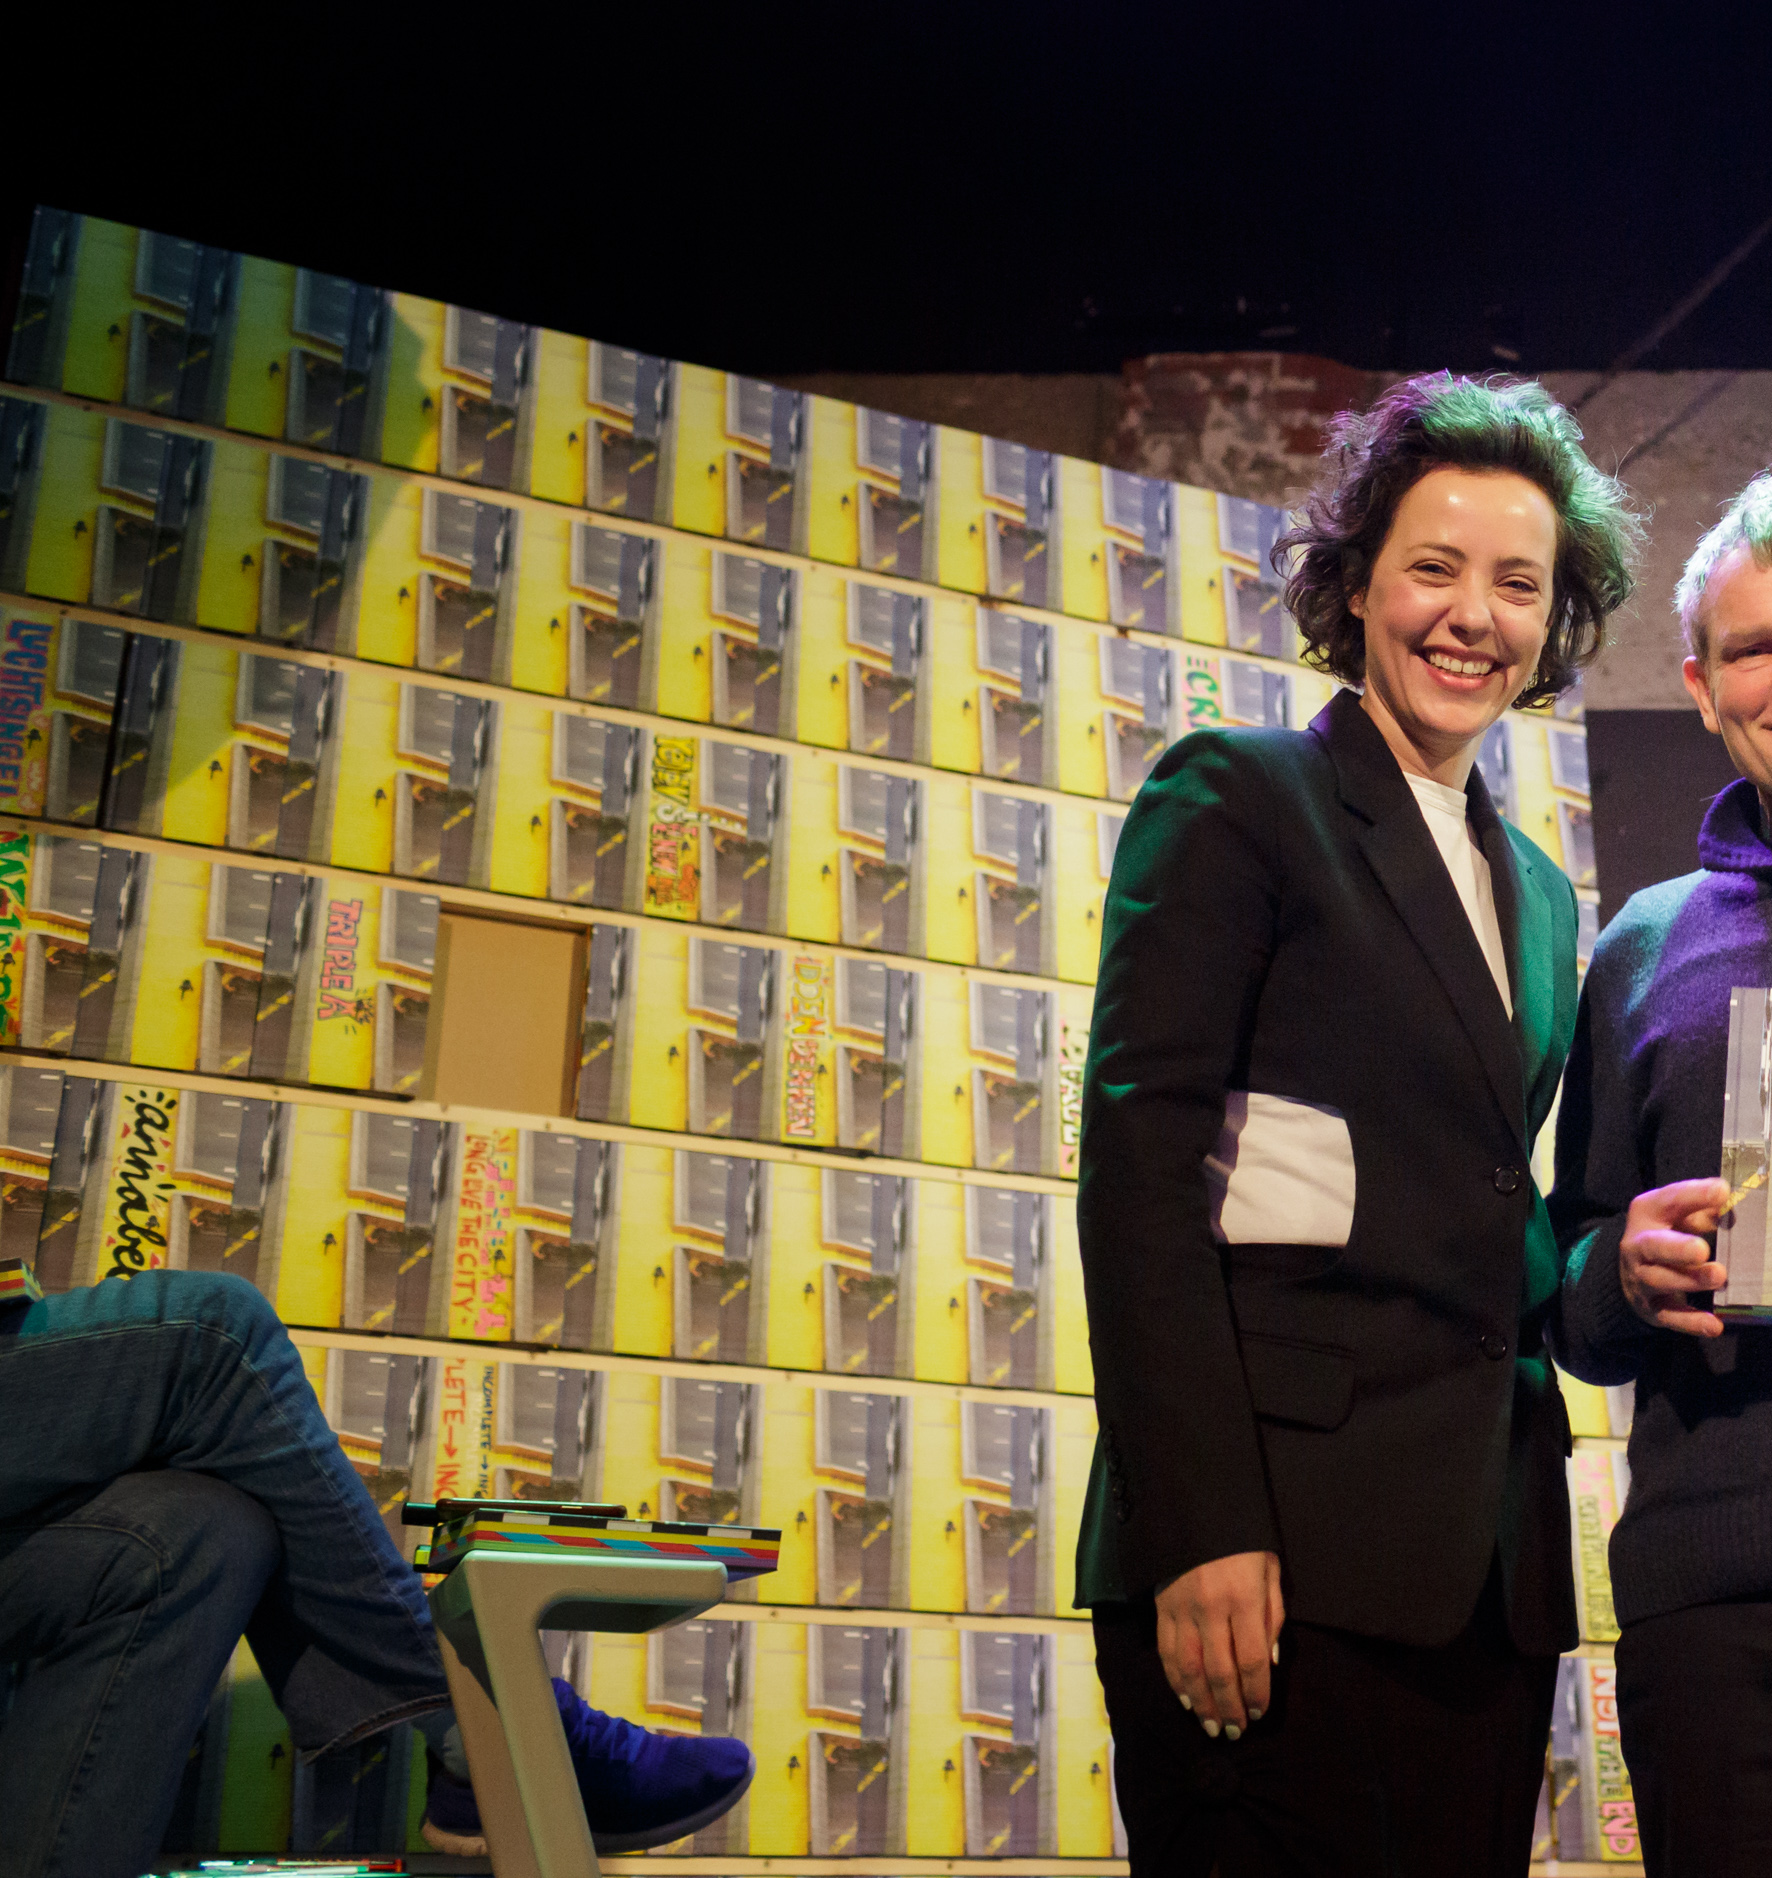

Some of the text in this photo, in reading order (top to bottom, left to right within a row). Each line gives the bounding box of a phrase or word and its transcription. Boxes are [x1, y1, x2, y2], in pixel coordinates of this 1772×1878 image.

[320, 898, 363, 991] TRIPLE
[457, 1214, 482, 1249] THE
[1600, 1801, 1639, 1856] END
